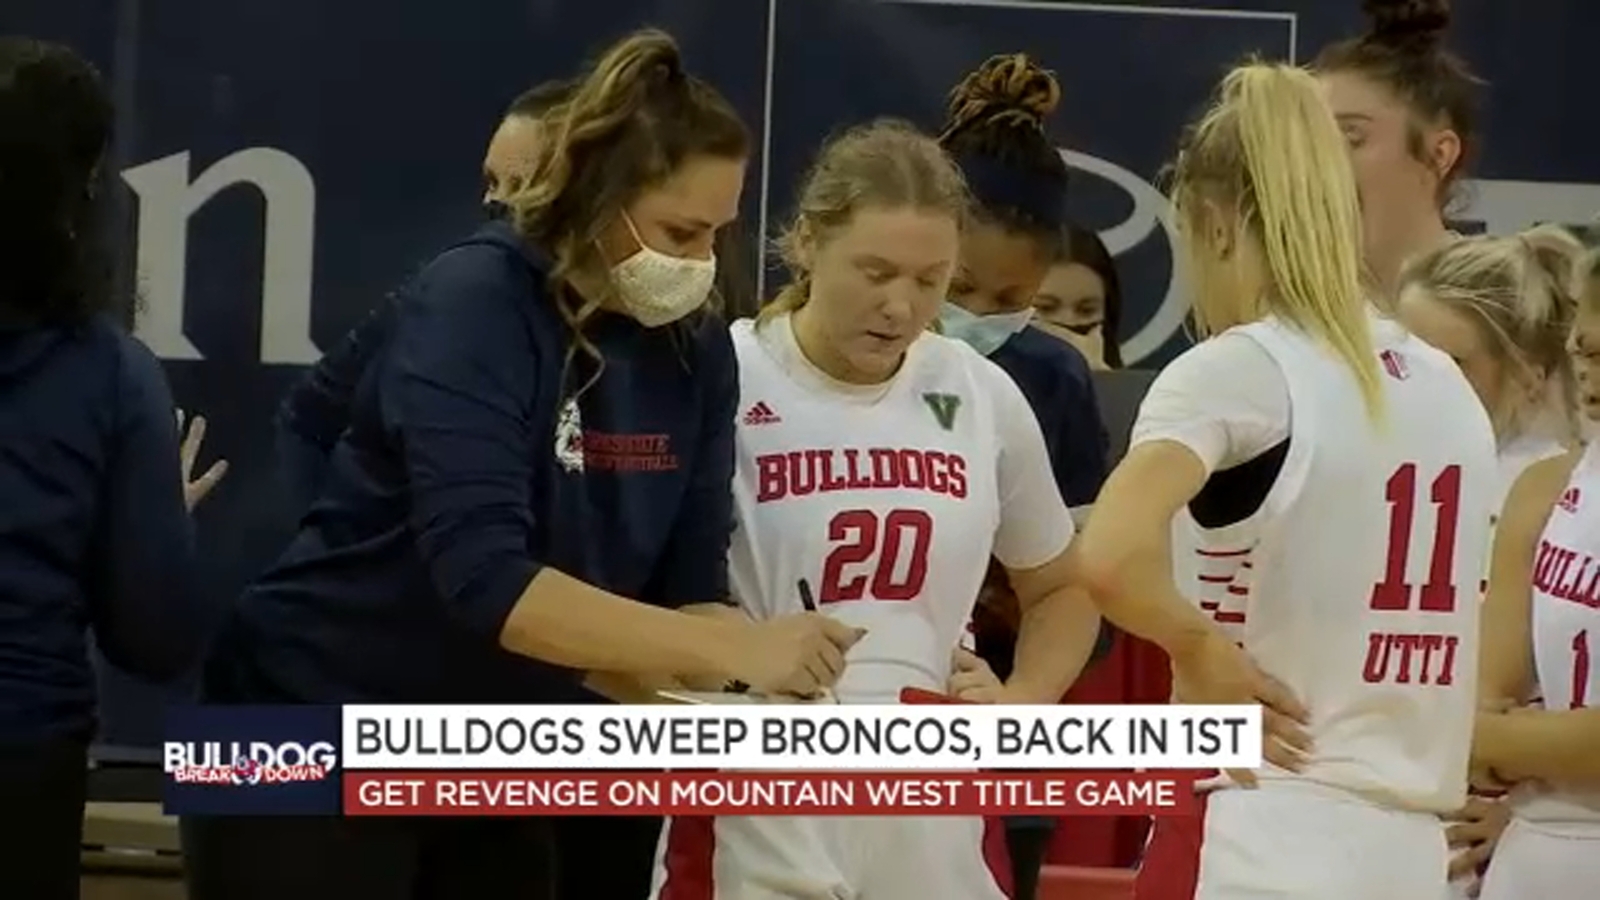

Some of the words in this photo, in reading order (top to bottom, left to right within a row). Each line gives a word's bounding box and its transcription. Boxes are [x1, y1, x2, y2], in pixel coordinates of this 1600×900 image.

[922, 392, 962, 431] V
[756, 449, 967, 503] BULLDOGS
[820, 509, 932, 604] 20
[1369, 463, 1461, 612] 11
[1362, 633, 1459, 686] UTTI
